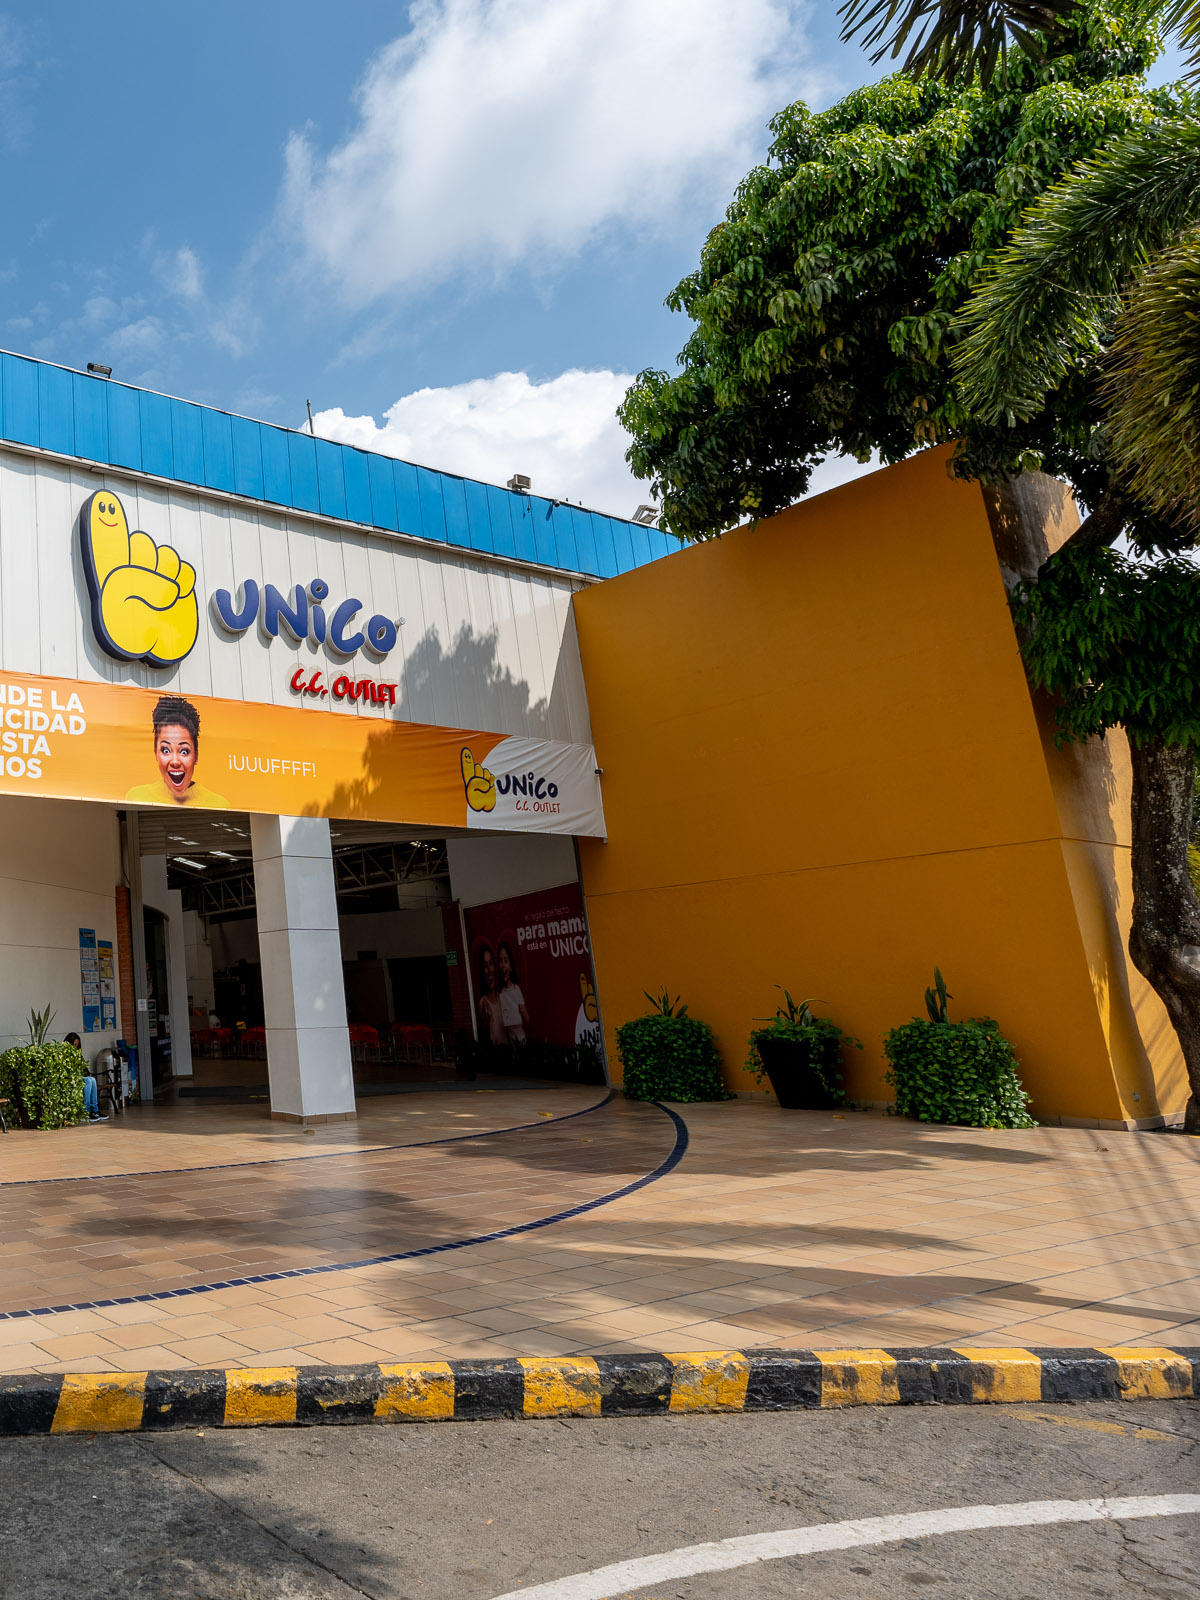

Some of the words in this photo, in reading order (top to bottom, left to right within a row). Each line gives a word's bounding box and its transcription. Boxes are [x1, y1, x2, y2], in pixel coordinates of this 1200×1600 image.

[290, 668, 328, 695] C.C.
[332, 675, 398, 705] OUTLET
[50, 688, 85, 714] LA
[228, 754, 317, 779] ¡UUUFFFF!
[515, 799, 531, 812] C.C.
[533, 801, 561, 814] OUTLET
[517, 923, 545, 946] para
[526, 940, 539, 951] está
[539, 941, 547, 949] en
